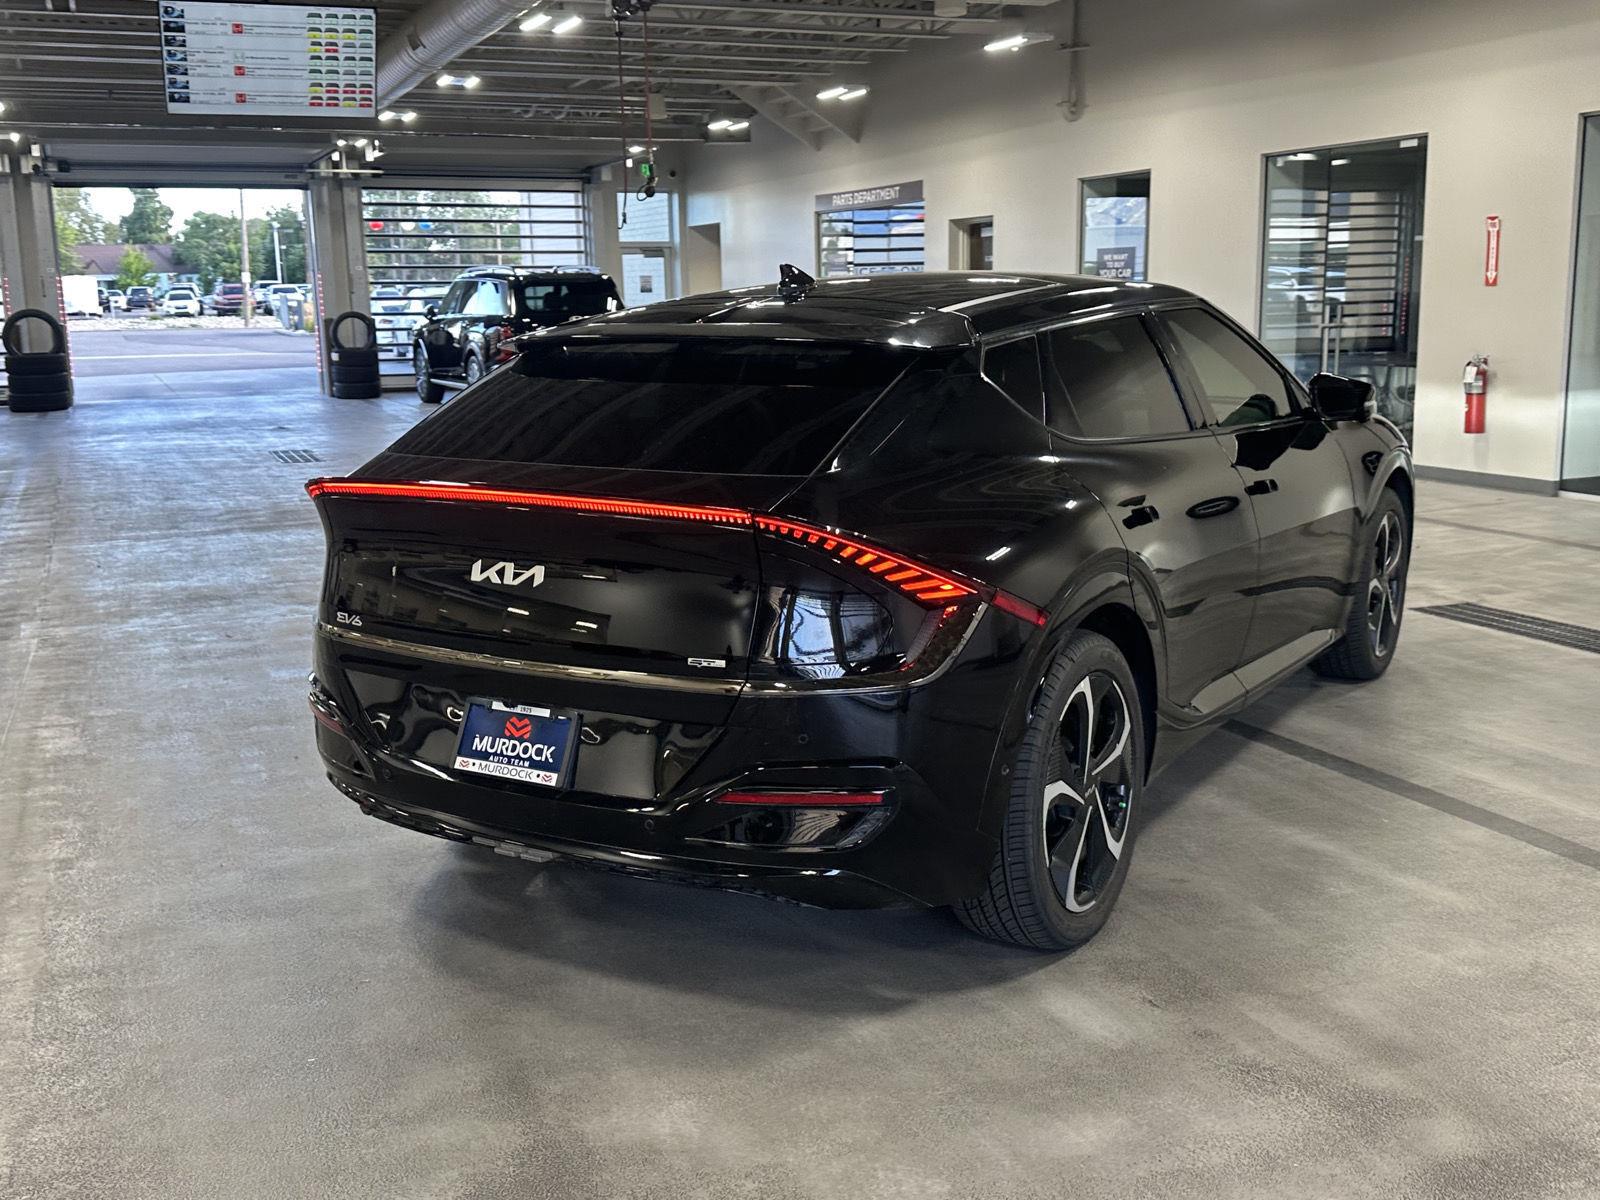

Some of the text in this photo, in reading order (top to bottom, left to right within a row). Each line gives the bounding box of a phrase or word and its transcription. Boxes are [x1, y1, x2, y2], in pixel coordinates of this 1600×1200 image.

[832, 186, 900, 206] PARTS DEPARTMENT
[1117, 268, 1132, 277] CAR
[470, 559, 545, 588] KIA
[336, 611, 363, 627] EV6
[472, 734, 556, 763] MURDOCK
[488, 755, 530, 768] AUTO TEAM
[478, 762, 533, 779] MURDOCK
